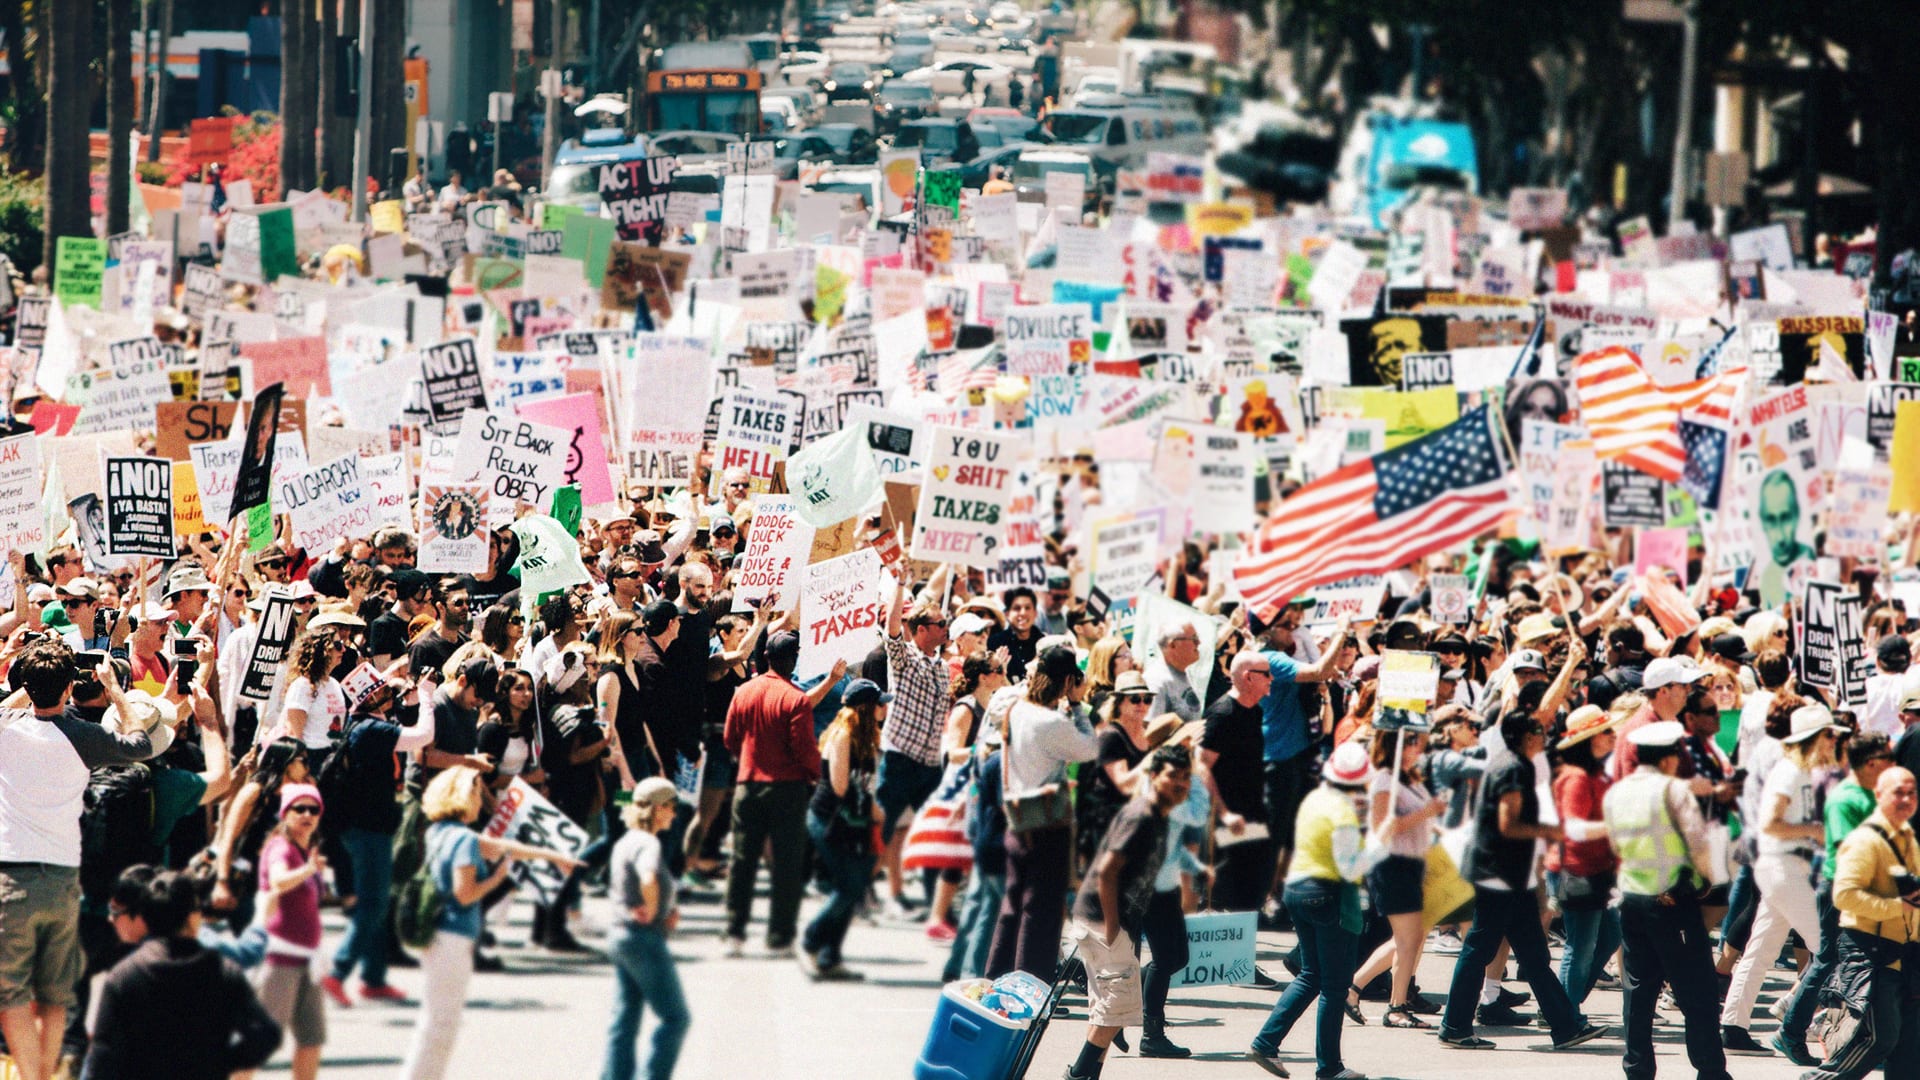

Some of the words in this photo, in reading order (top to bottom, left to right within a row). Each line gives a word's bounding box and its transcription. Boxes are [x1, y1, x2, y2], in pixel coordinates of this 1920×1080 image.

[599, 160, 642, 193] ACT
[646, 156, 677, 185] UP
[608, 193, 668, 224] FIGHT
[528, 232, 562, 253] NO!
[1550, 302, 1593, 322] WHAT
[1007, 315, 1085, 339] DIVULGE
[423, 342, 475, 380] NO!
[732, 406, 787, 433] TAXES
[481, 415, 512, 445] SIT
[515, 422, 555, 457] BACK
[193, 446, 241, 469] TRUMP
[951, 436, 1000, 462] YOU
[486, 446, 538, 479] RELAX
[629, 450, 688, 479] HATE
[722, 446, 773, 478] HELL
[110, 461, 169, 499] ¡NO!
[282, 454, 359, 510] OLIGARCHY
[955, 465, 1009, 490] SHIT
[337, 488, 361, 506] NEW
[494, 474, 548, 505] OBEY
[136, 500, 167, 515] BASTA!
[932, 495, 1001, 525] TAXES
[300, 503, 372, 551] DEMOCRACY
[755, 515, 795, 529] DODGE
[16, 527, 42, 546] KING
[751, 529, 786, 543] DUCK
[748, 544, 770, 556] DIP
[743, 558, 776, 572] DIVE
[781, 557, 791, 571] &
[741, 572, 785, 586] DODGE
[850, 580, 865, 592] US
[810, 602, 877, 645] TAXES
[1807, 645, 1834, 661] TRUM
[252, 660, 277, 674] TRUM
[1187, 928, 1243, 943] PRESIDEN
[1198, 951, 1212, 960] MY
[1182, 963, 1225, 985] NOT
